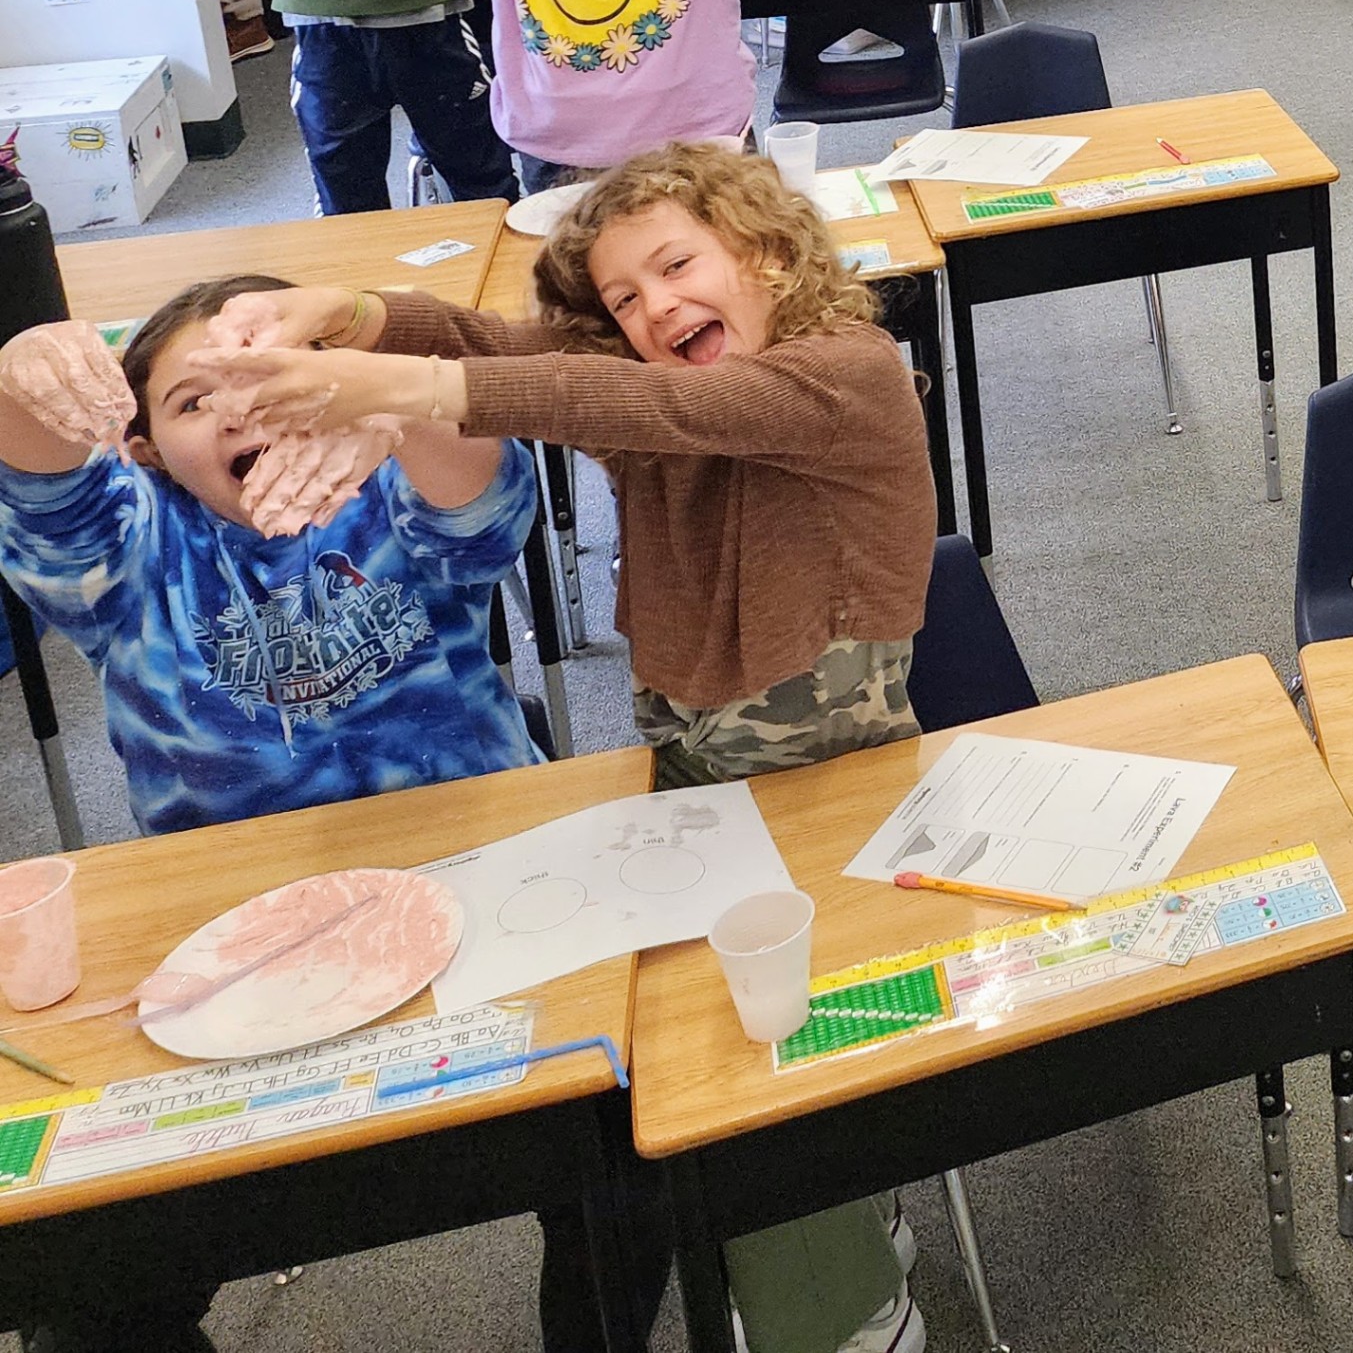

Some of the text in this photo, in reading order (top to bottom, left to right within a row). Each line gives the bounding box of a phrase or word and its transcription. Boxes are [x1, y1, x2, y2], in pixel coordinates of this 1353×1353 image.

[1165, 797, 1186, 818] Lava
[1137, 813, 1172, 862] Experiment
[1129, 859, 1143, 874] #2
[519, 871, 550, 885] thick
[421, 1015, 444, 1032] Pp
[448, 1011, 474, 1026] Oo
[357, 1032, 379, 1046] Rr
[450, 1031, 471, 1047] Bb
[477, 1024, 502, 1040] Aa
[330, 1038, 351, 1053] Ss
[386, 1044, 413, 1061] Dd
[418, 1038, 442, 1054] Cc
[326, 1058, 352, 1074] Ff
[357, 1051, 381, 1067] Ee
[200, 1065, 231, 1081] Ww
[294, 1062, 321, 1081] Gg
[262, 1073, 288, 1088] Hh
[156, 1095, 177, 1112] Ll
[182, 1090, 205, 1106] Kk
[118, 1100, 154, 1120] Mm
[276, 1095, 361, 1123] Reagan
